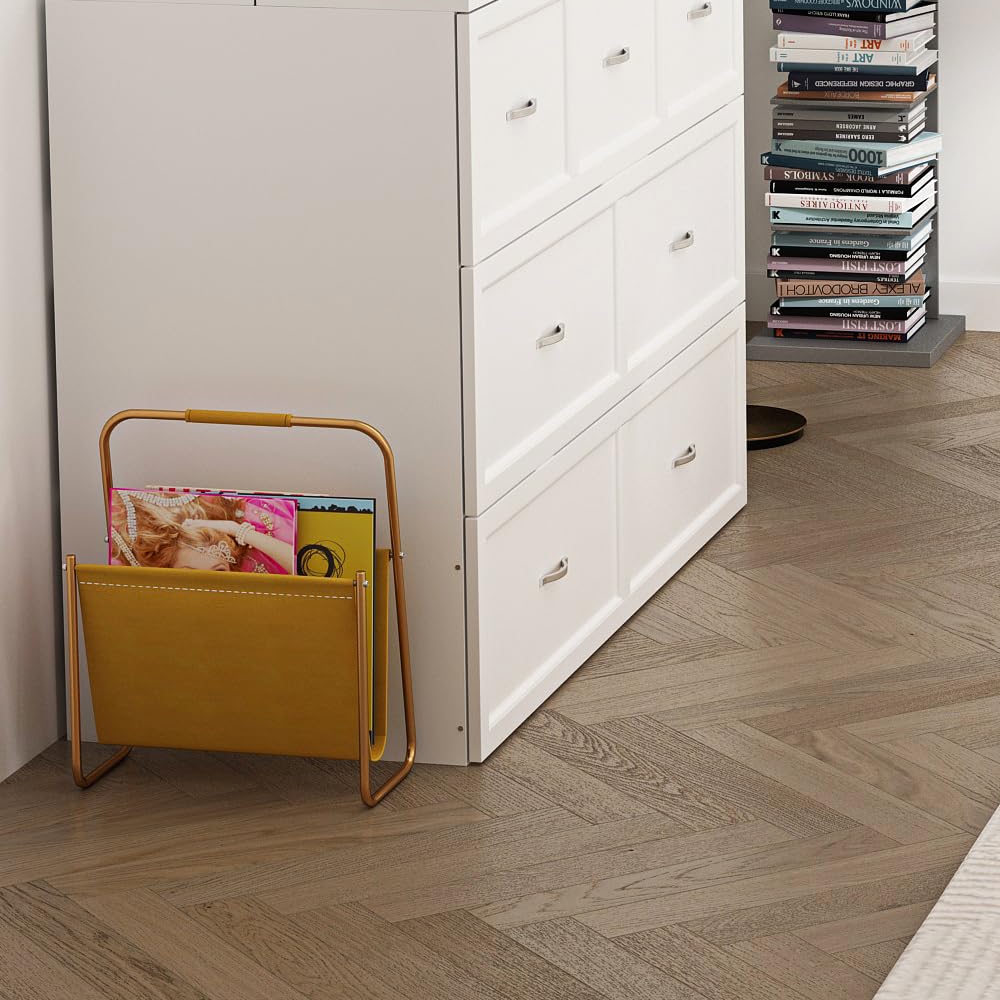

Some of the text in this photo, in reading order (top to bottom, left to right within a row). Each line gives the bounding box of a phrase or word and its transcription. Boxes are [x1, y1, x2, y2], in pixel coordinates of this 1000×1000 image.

[860, 40, 882, 49] ART
[852, 53, 873, 63] ART
[848, 148, 884, 164] 1000
[784, 170, 834, 180] SYMBOLS
[800, 200, 868, 210] ANTIQUAIRES
[842, 261, 901, 272] LOST FISH
[787, 284, 868, 295] BRODOVITCH
[872, 283, 920, 294] ALEXEY
[842, 320, 901, 331] LOST FISH
